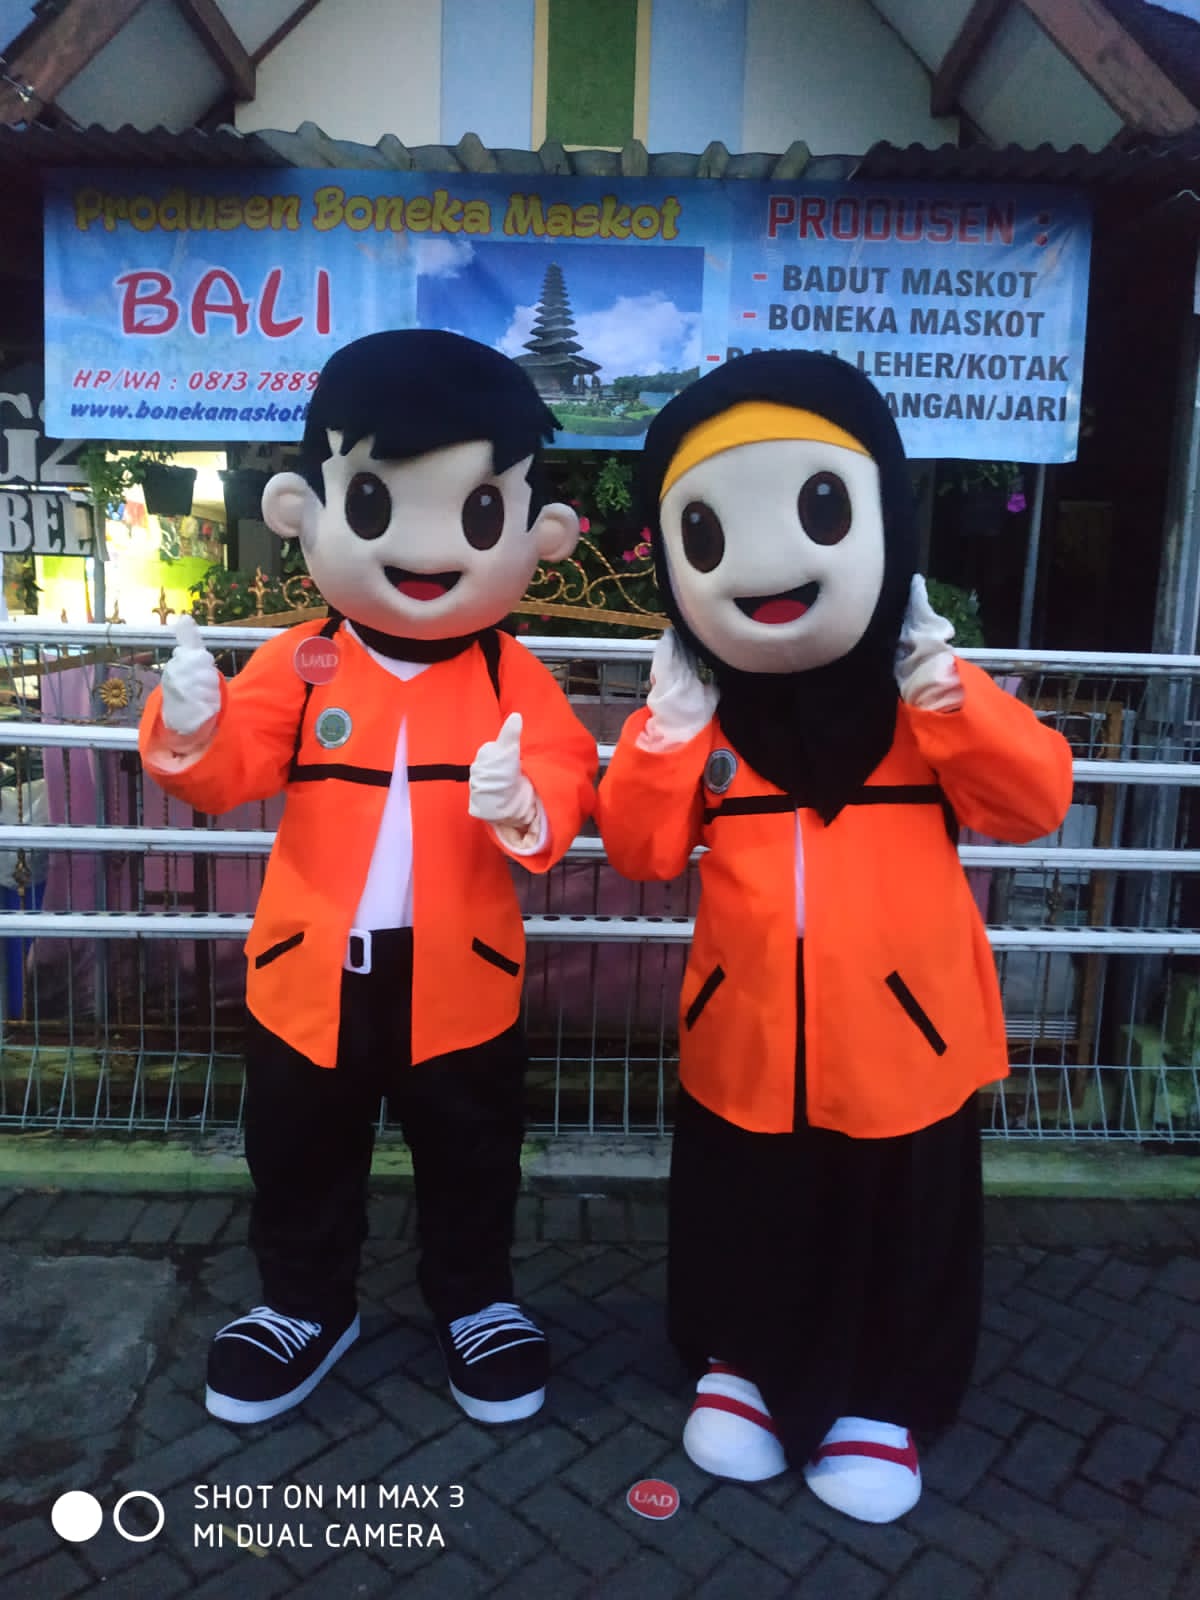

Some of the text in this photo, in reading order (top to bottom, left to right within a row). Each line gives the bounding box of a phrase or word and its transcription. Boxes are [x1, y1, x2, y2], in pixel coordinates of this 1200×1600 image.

[74, 185, 681, 240] Produsen Boneka Maskot
[767, 195, 1016, 246] PRODUSEN
[783, 264, 890, 294] BADUT
[901, 267, 1038, 298] MASKOT
[115, 267, 332, 338] BALI
[768, 304, 898, 334] BONEKA
[909, 308, 1045, 338] MASKOT
[73, 369, 161, 391] HP/WA
[188, 371, 248, 391] 0813
[257, 371, 320, 391] 7889
[857, 350, 1070, 381] LEHER/KOTAK
[634, 1490, 673, 1508] UAD
